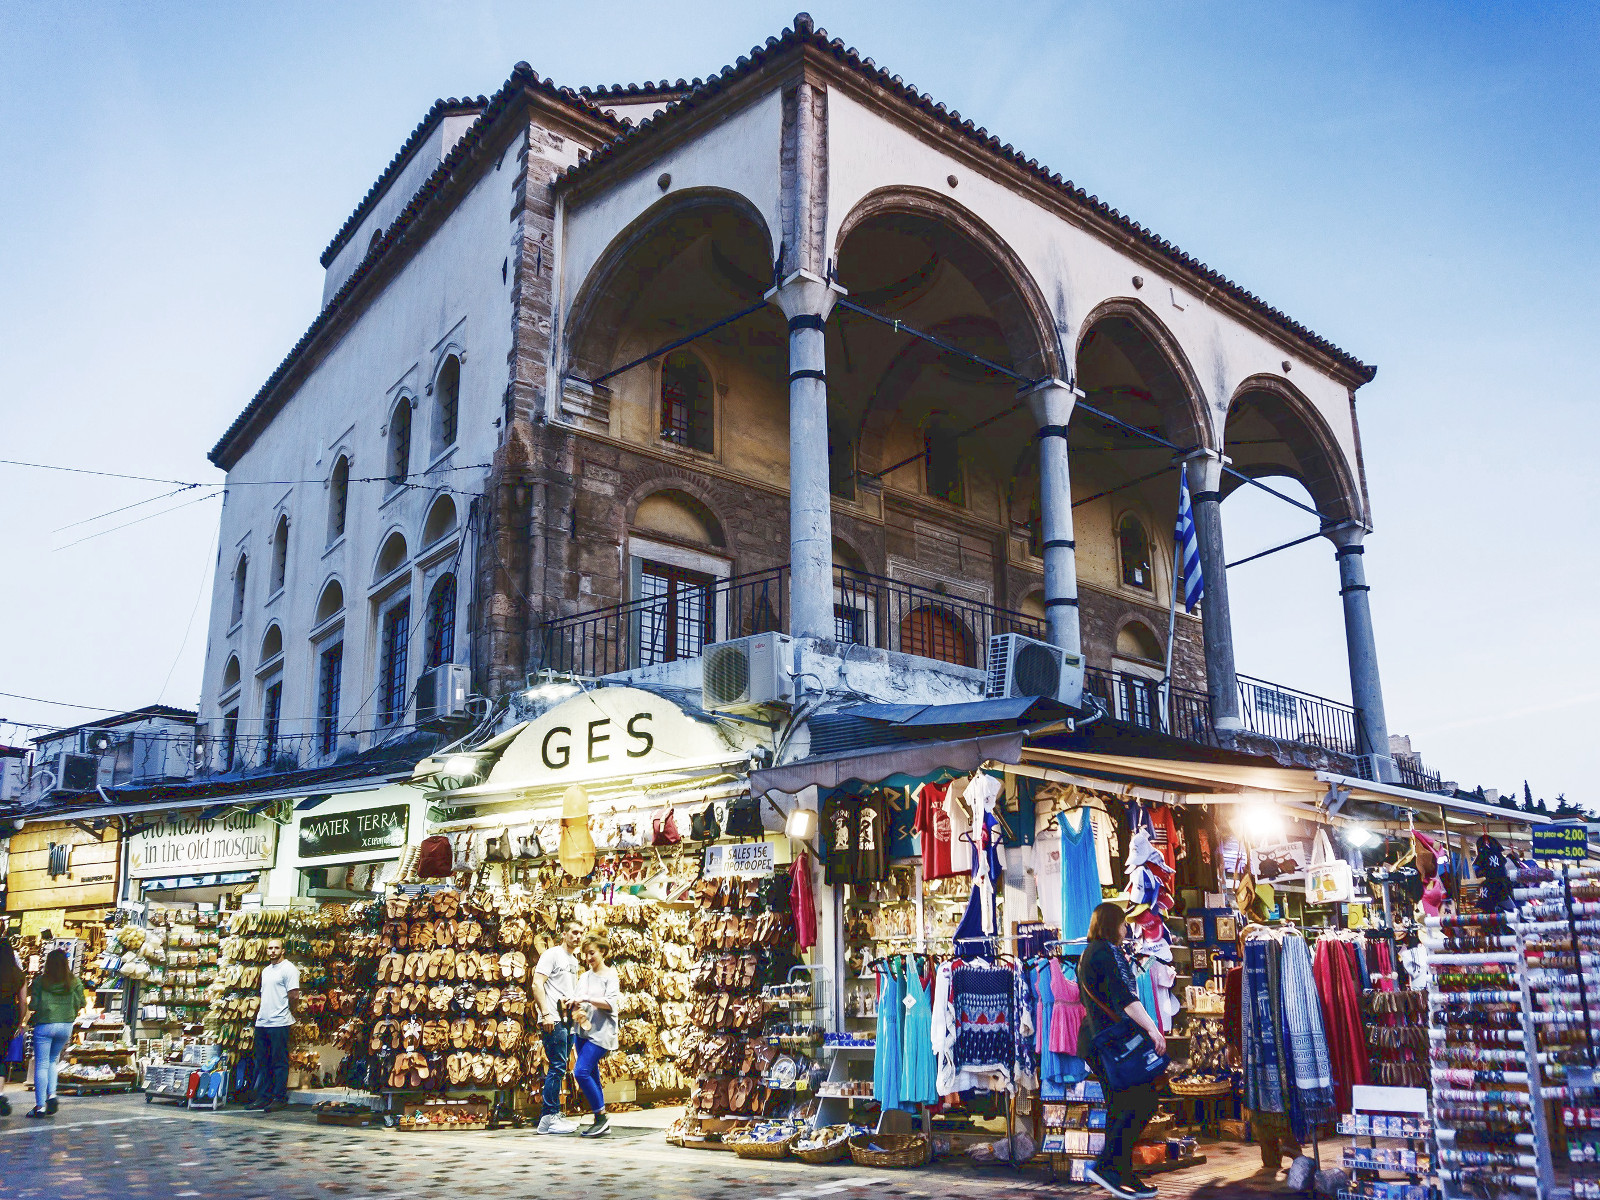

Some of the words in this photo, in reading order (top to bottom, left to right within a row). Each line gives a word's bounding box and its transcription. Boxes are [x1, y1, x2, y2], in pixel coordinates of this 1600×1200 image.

[541, 712, 654, 770] GES
[306, 818, 350, 839] MATER
[357, 811, 398, 832] TERRA
[145, 842, 157, 864] in
[162, 840, 185, 862] the
[188, 837, 210, 861] old
[213, 834, 267, 860] mosque
[727, 846, 751, 860] SALES
[753, 845, 768, 859] 15€
